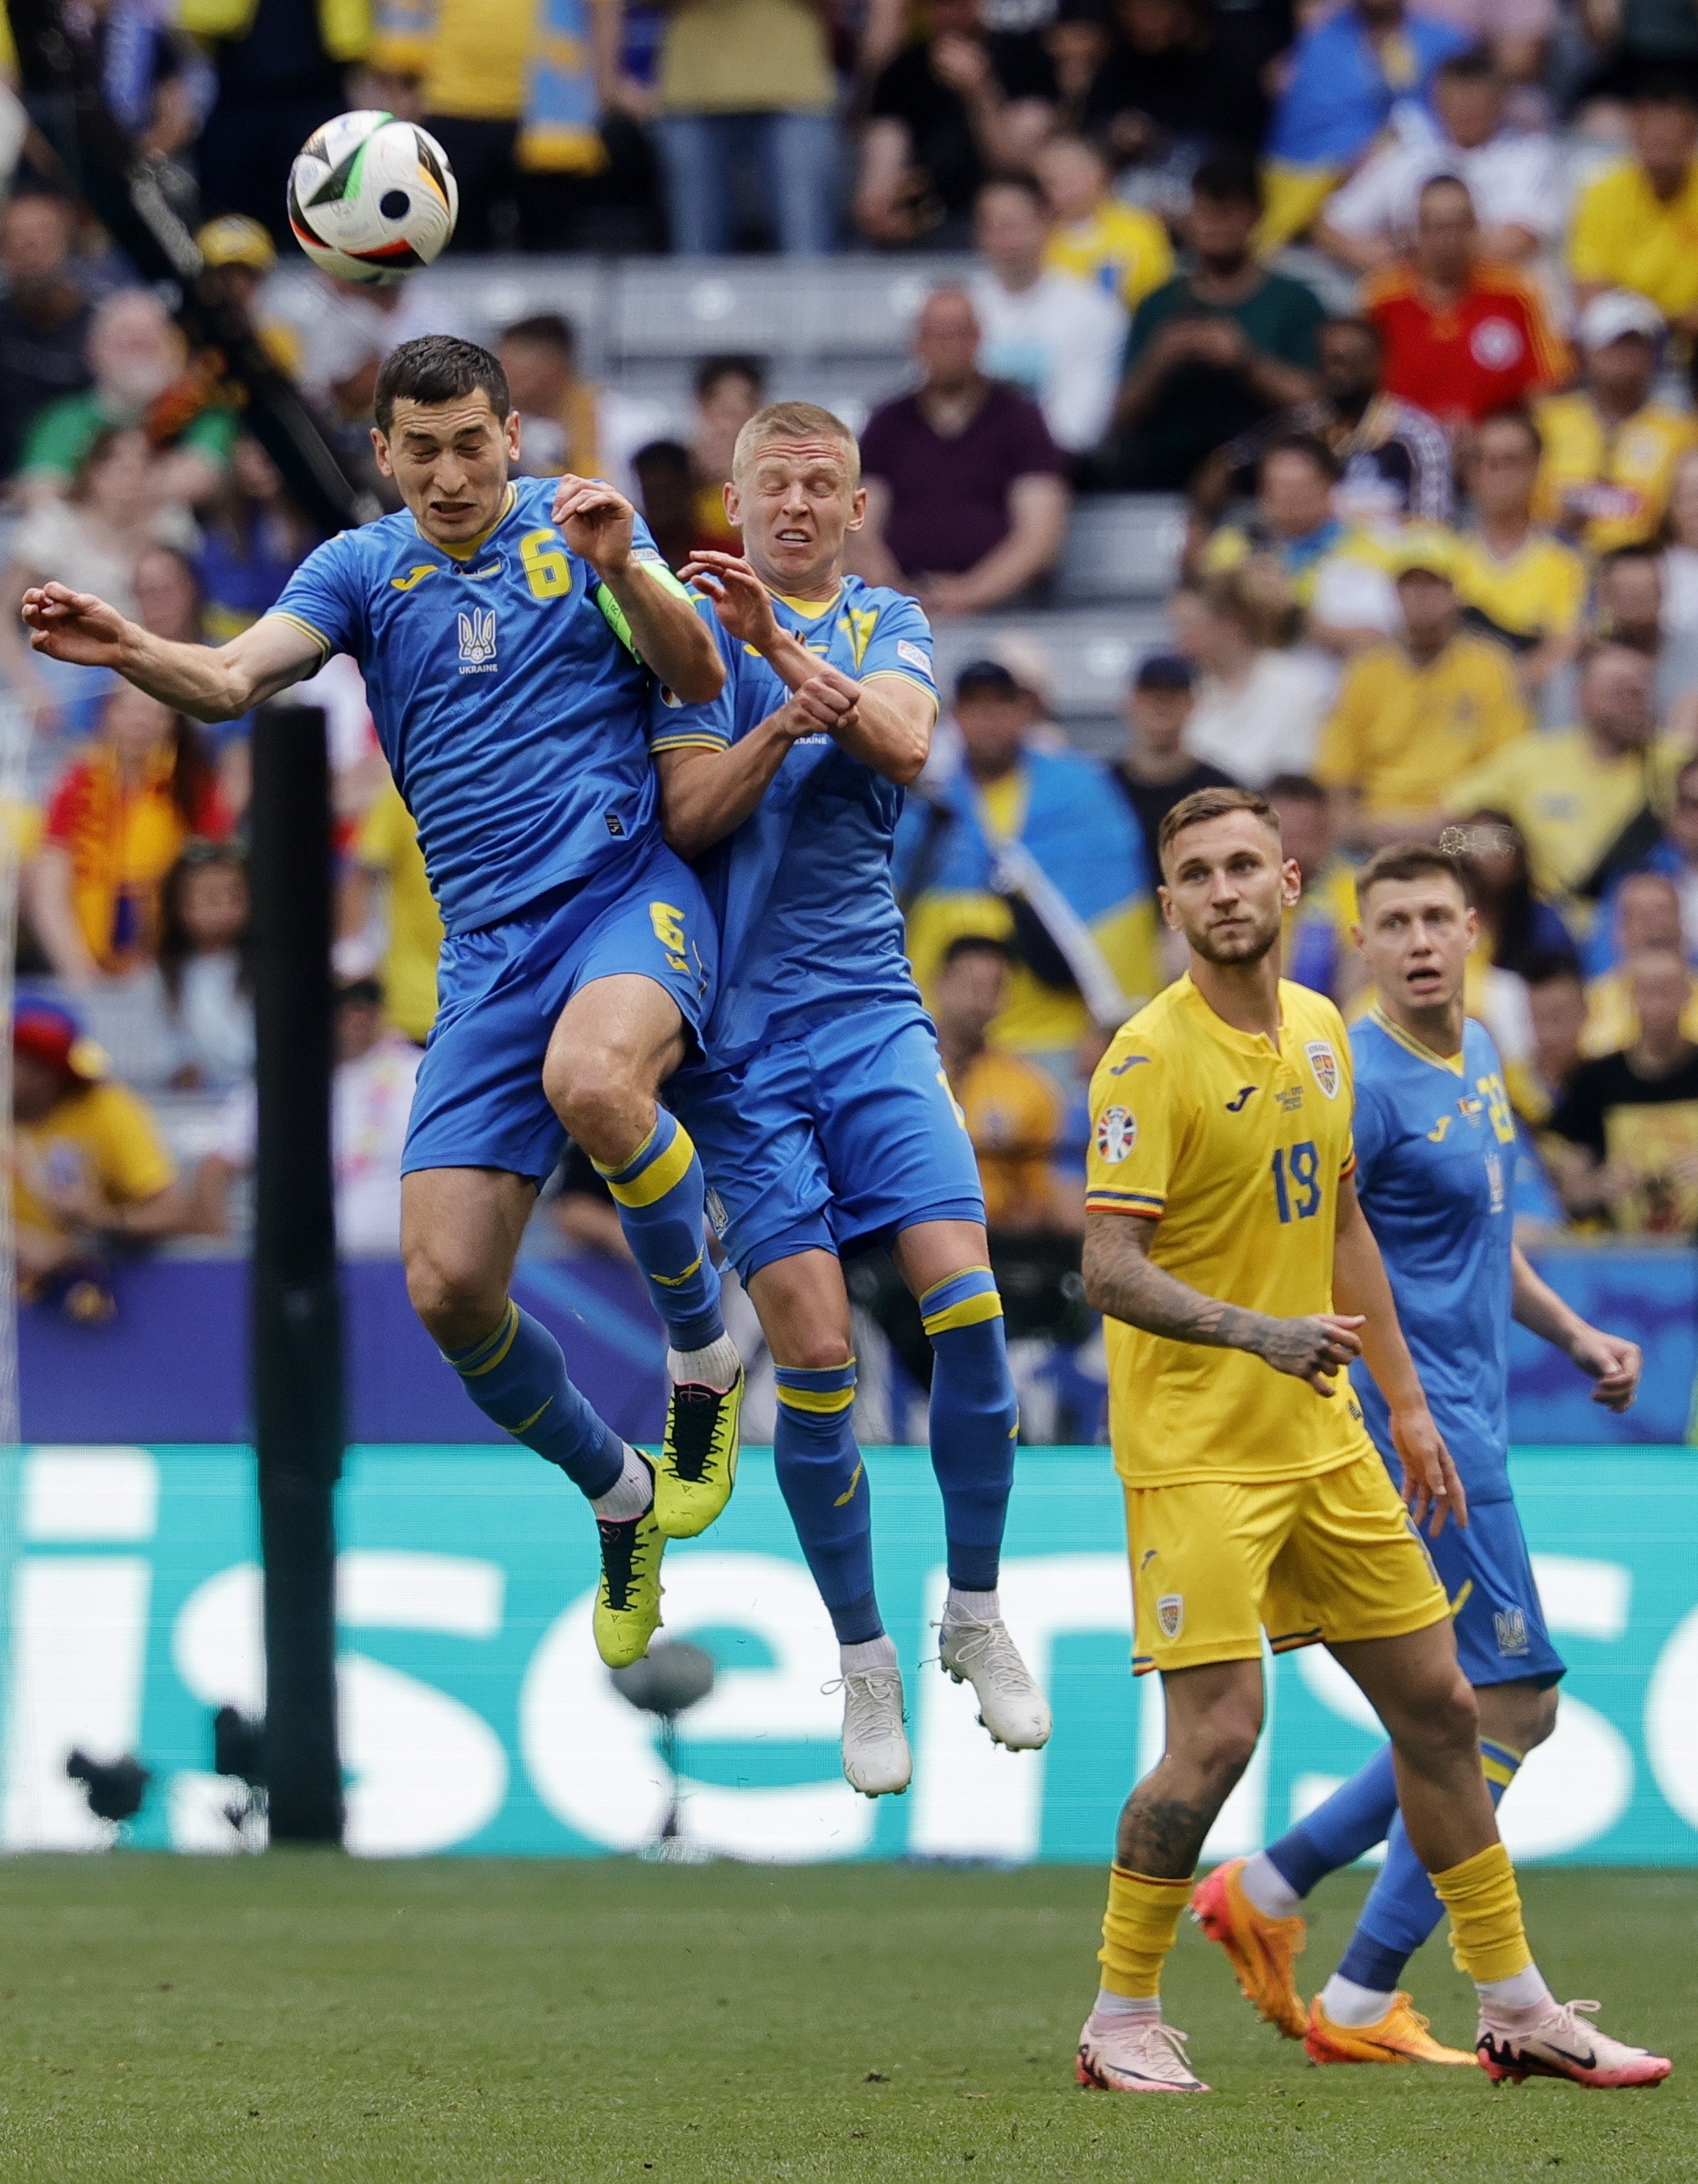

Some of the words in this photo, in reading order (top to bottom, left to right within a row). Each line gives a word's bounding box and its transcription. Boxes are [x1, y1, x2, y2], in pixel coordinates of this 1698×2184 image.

[519, 529, 572, 600] 6
[459, 664, 498, 674] UKRAINE
[649, 901, 691, 975] 6
[1271, 1140, 1321, 1222] 19
[3, 1443, 1698, 1864] isens
